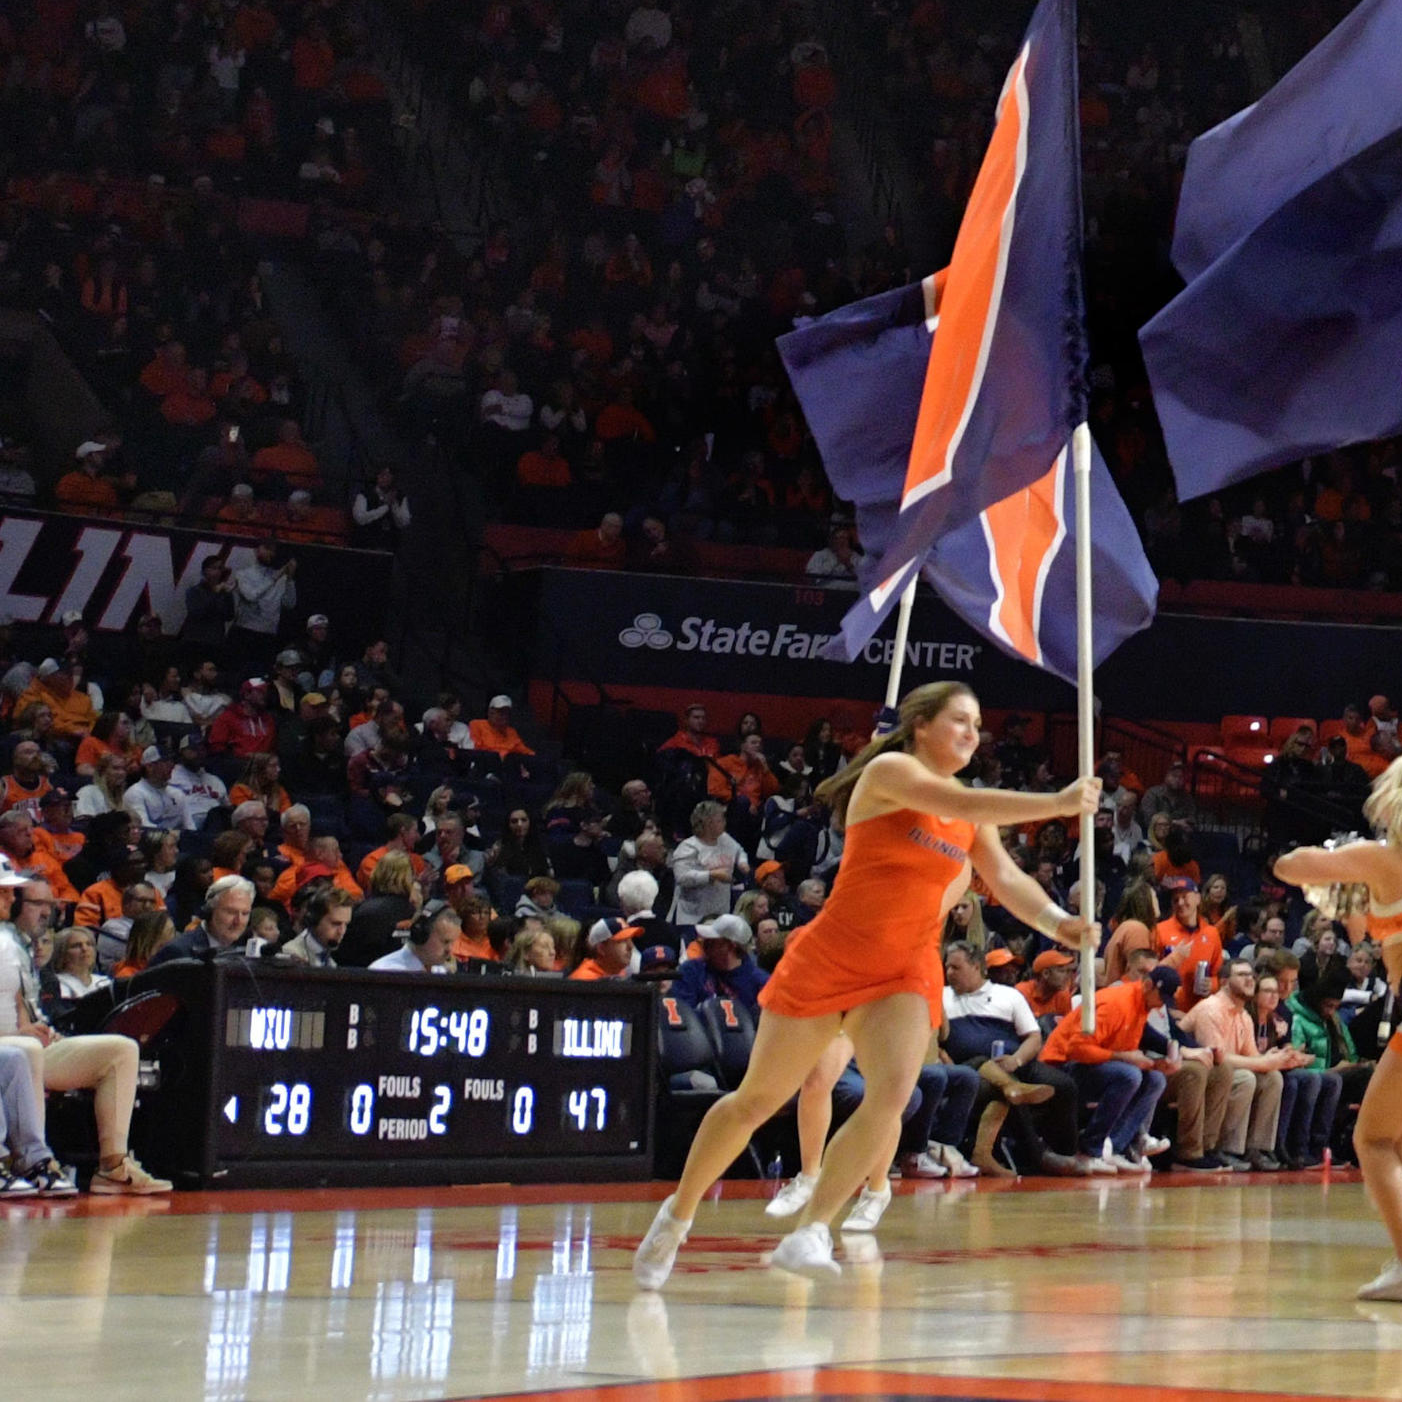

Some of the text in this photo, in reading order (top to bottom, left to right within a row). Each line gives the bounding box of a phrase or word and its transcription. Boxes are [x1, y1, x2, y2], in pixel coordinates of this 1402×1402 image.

[770, 624, 832, 662] Far
[409, 1007, 489, 1057] 15:48
[562, 1019, 624, 1058] ILLINI
[264, 1083, 311, 1135] 28
[378, 1076, 421, 1098] FOULS
[464, 1078, 505, 1100] FOULS
[569, 1087, 607, 1131] 47
[351, 1084, 373, 1135] 0
[378, 1118, 429, 1140] PERIOD
[429, 1085, 451, 1134] 2
[513, 1086, 534, 1134] 0
